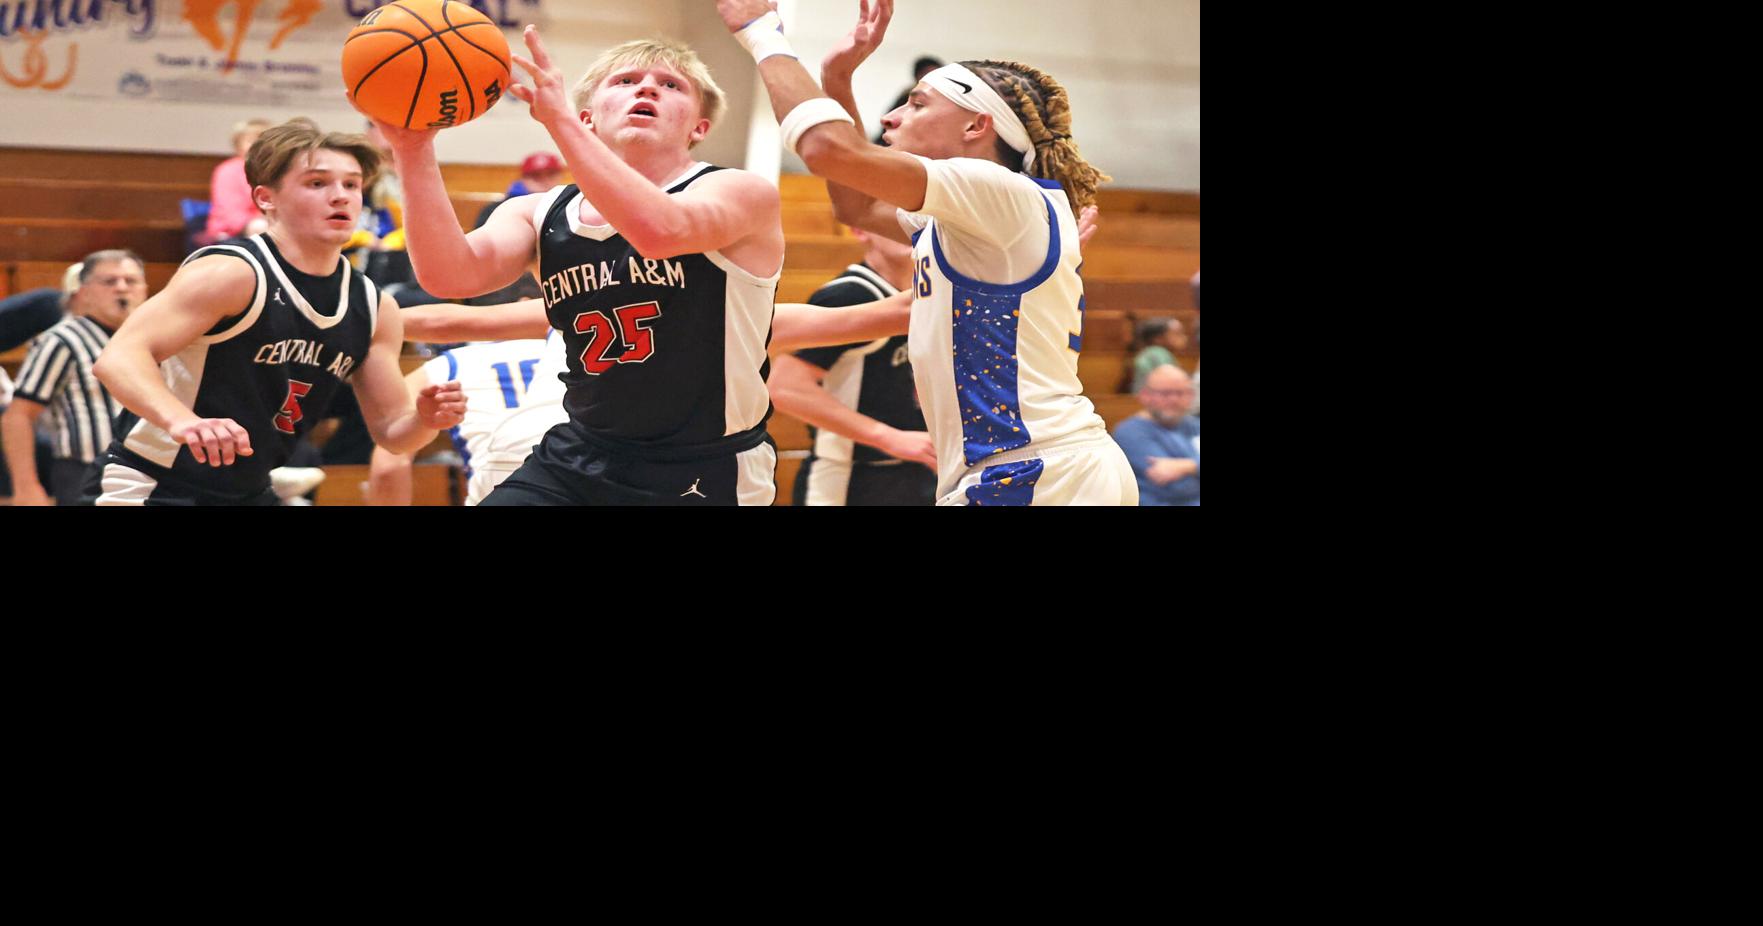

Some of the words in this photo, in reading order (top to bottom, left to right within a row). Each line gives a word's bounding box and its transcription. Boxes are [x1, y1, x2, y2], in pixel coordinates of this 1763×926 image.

[543, 260, 620, 308] CENTRAL
[629, 256, 685, 288] A&M
[254, 339, 324, 366] CENTRAL
[326, 351, 355, 379] A&
[573, 301, 662, 375] 25
[272, 378, 313, 434] 5
